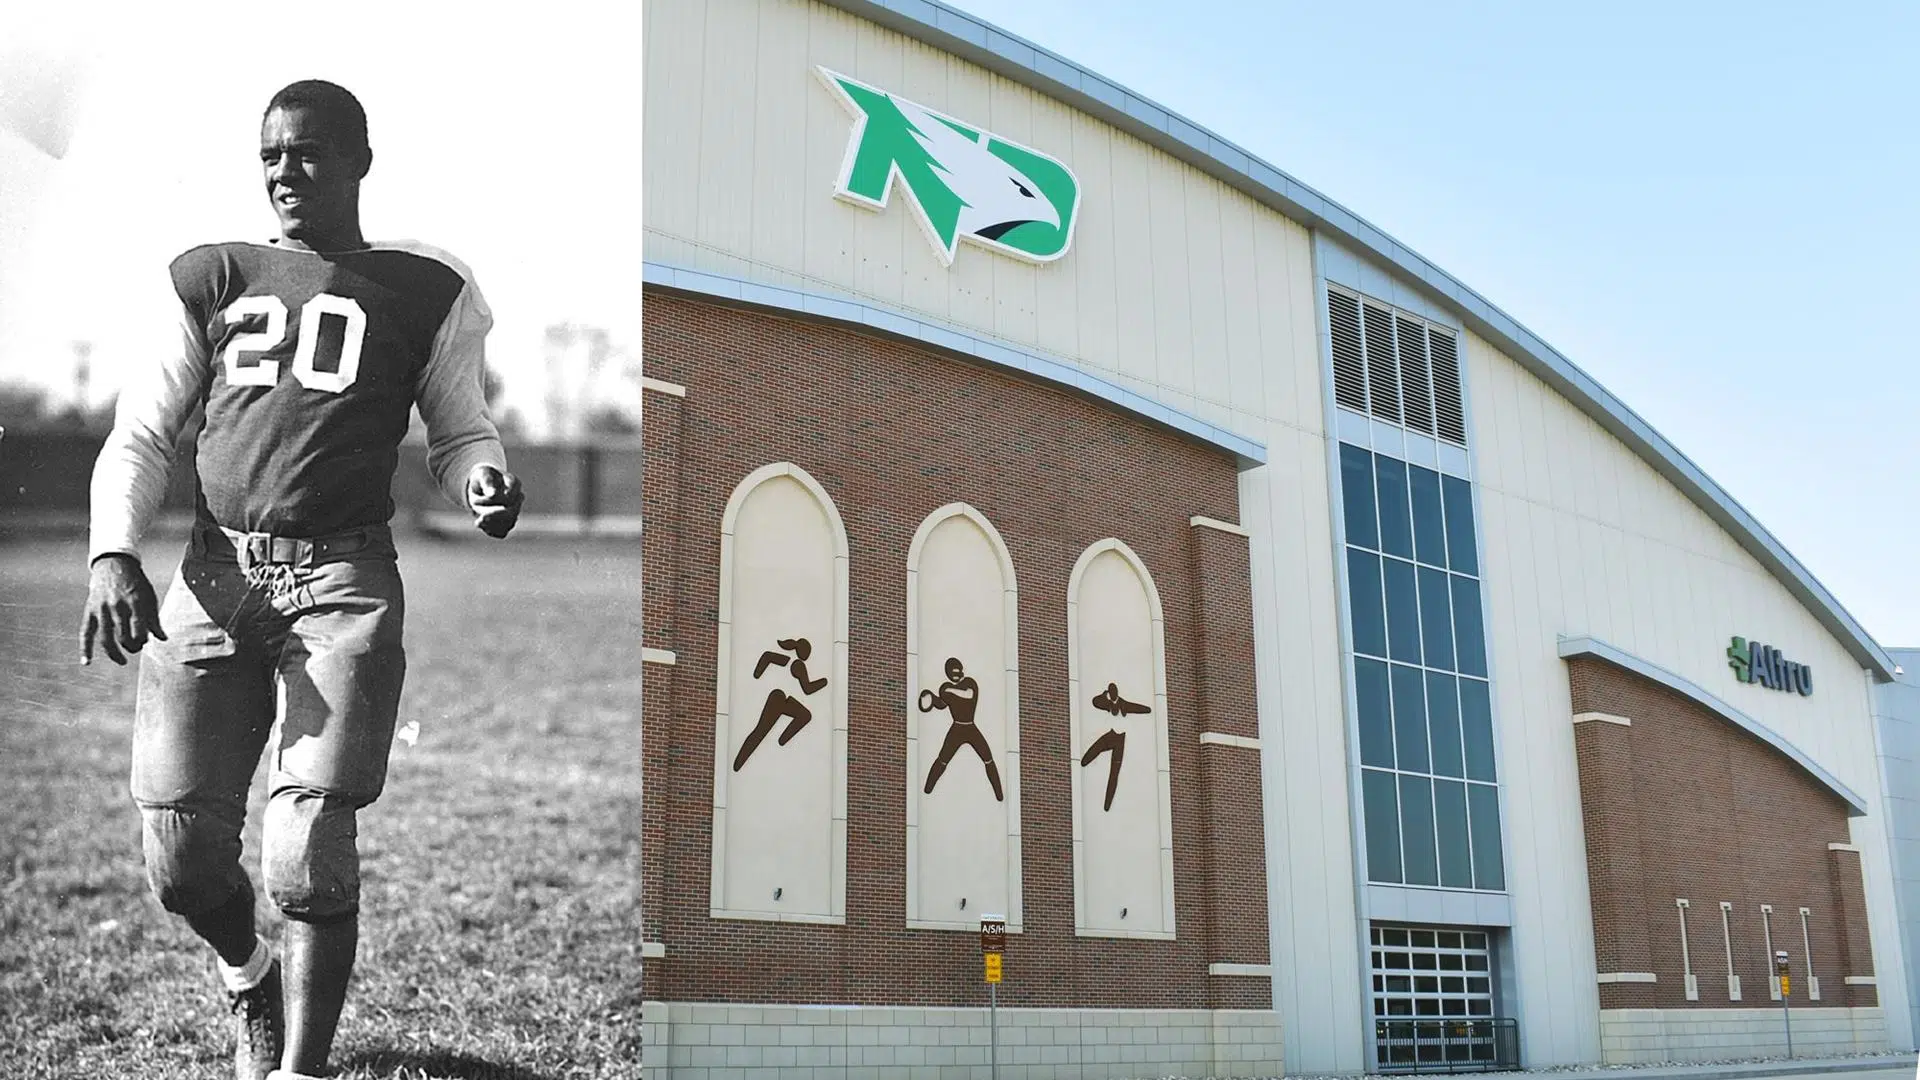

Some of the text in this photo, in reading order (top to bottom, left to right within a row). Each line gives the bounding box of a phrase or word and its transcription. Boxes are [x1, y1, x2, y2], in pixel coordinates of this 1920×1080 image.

[222, 293, 367, 393] 20
[1748, 641, 1813, 697] Altru
[982, 924, 1005, 935] A/S/H
